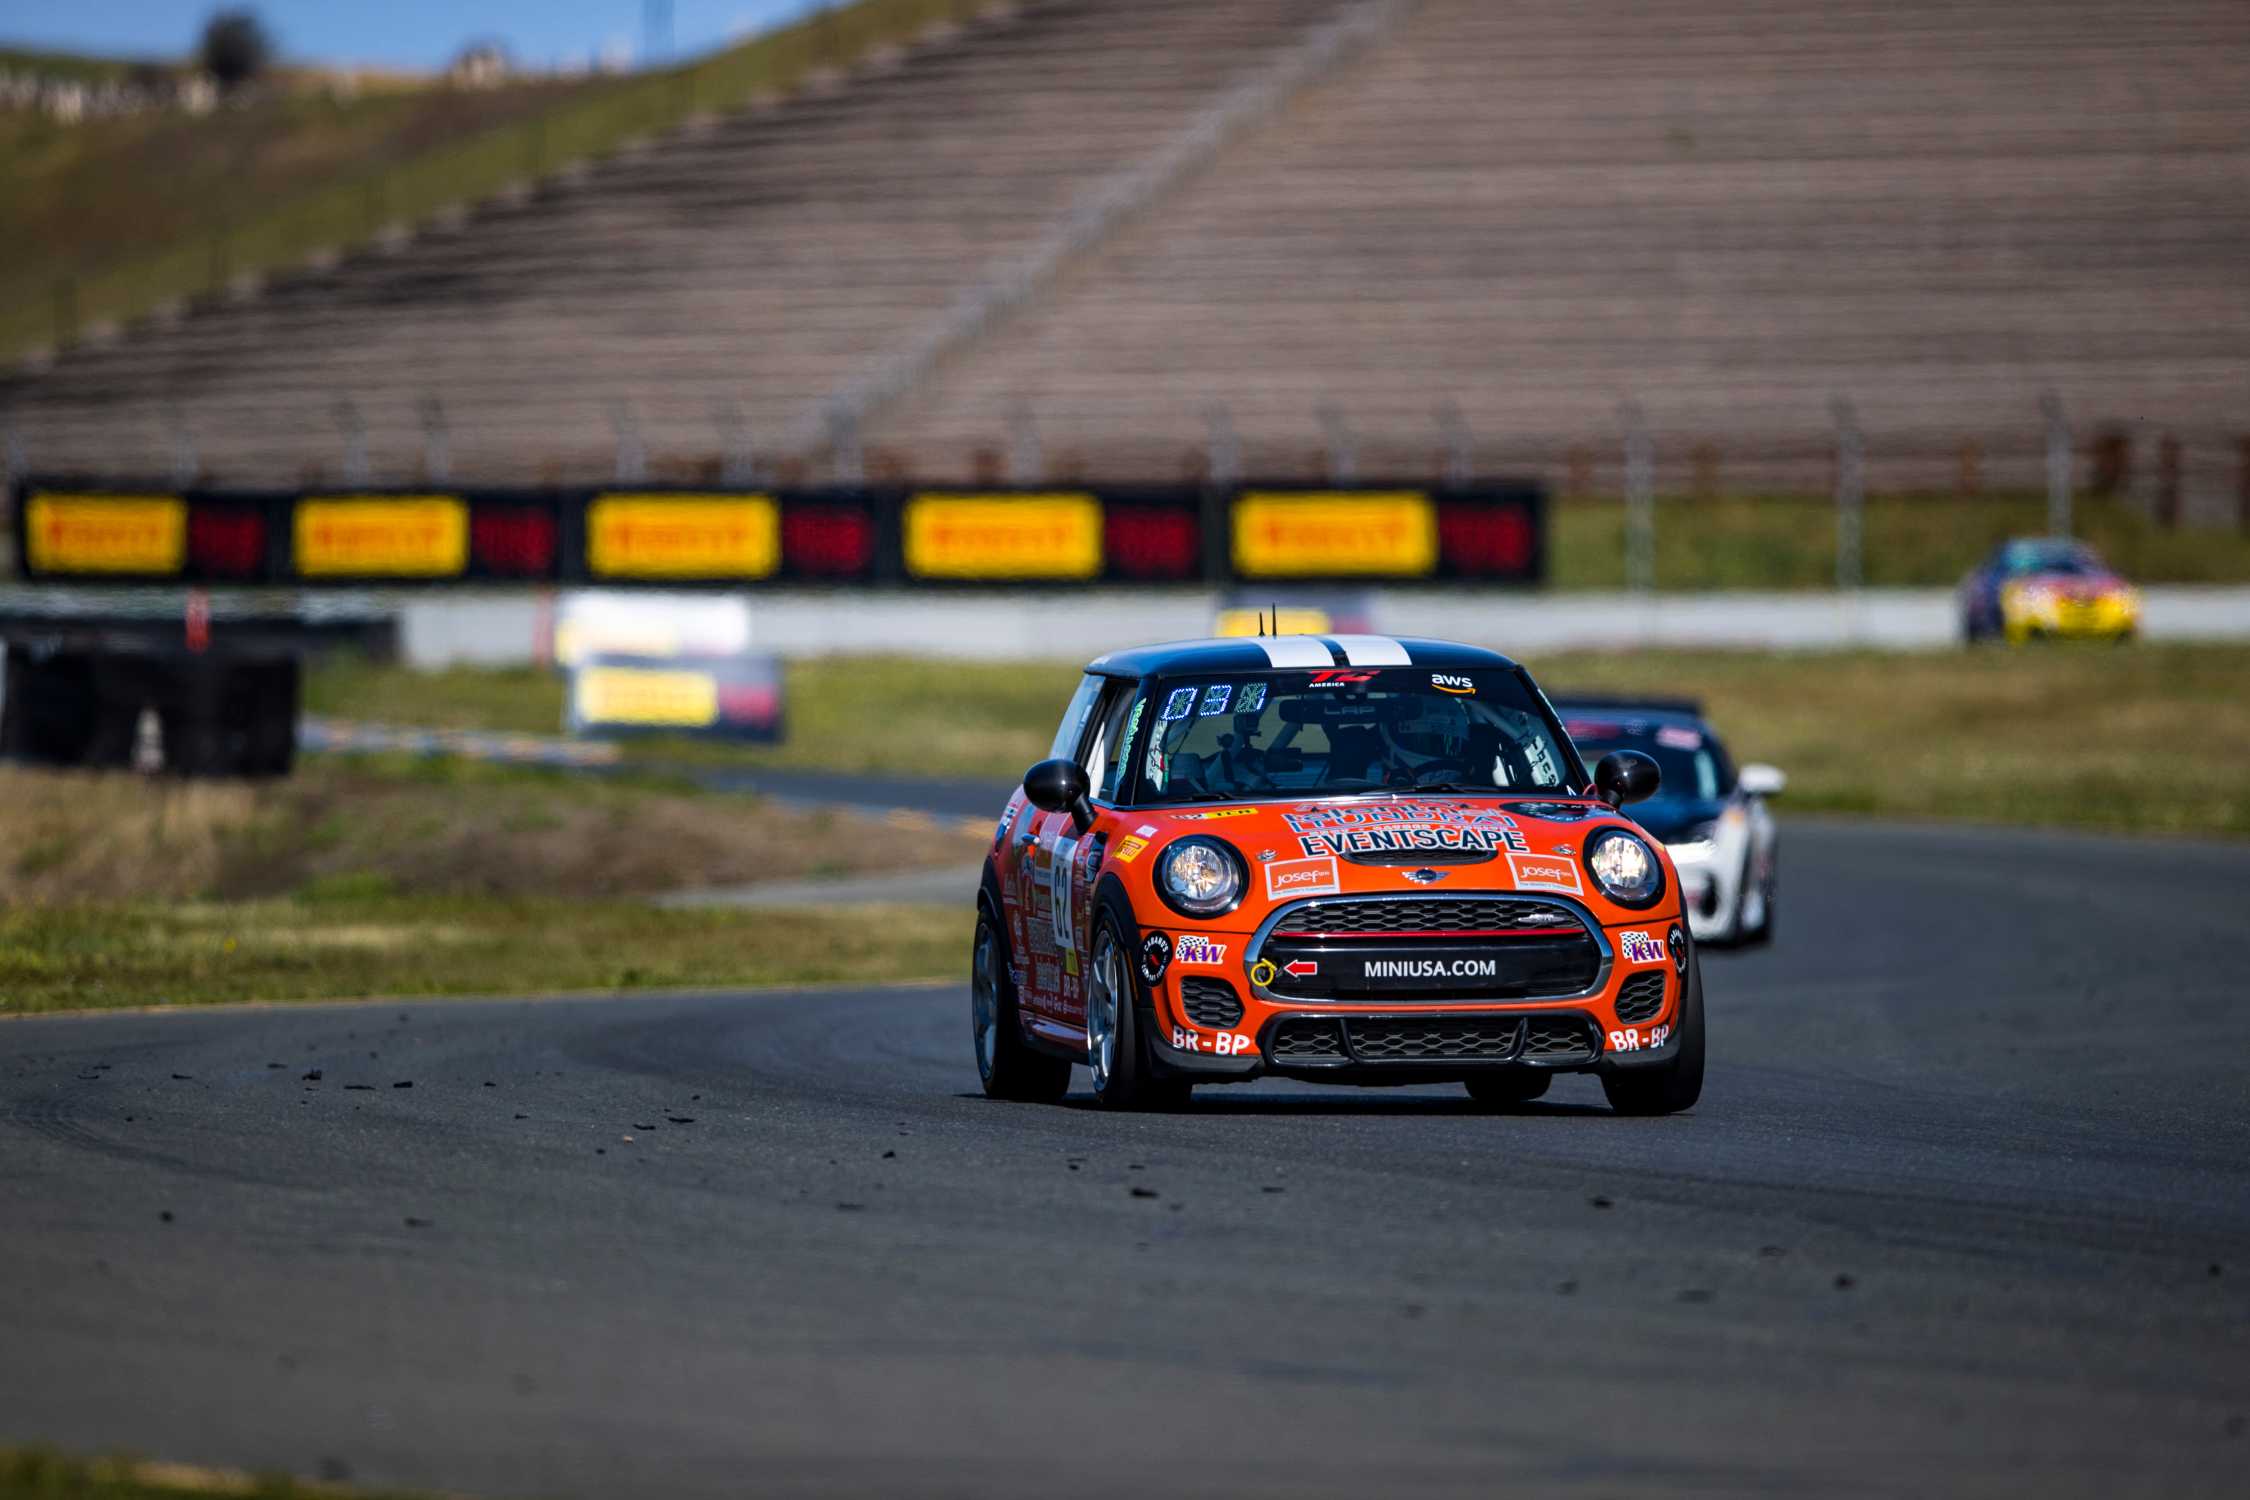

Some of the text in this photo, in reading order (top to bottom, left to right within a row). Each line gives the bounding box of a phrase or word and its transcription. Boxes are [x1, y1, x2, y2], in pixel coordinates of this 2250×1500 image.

[1431, 673, 1473, 688] aws
[1298, 827, 1531, 858] EVENTSCAPE
[1054, 865, 1071, 940] 62
[1183, 944, 1224, 962] KW
[1631, 940, 1664, 961] KW
[1364, 960, 1496, 977] MINIUSA.COM
